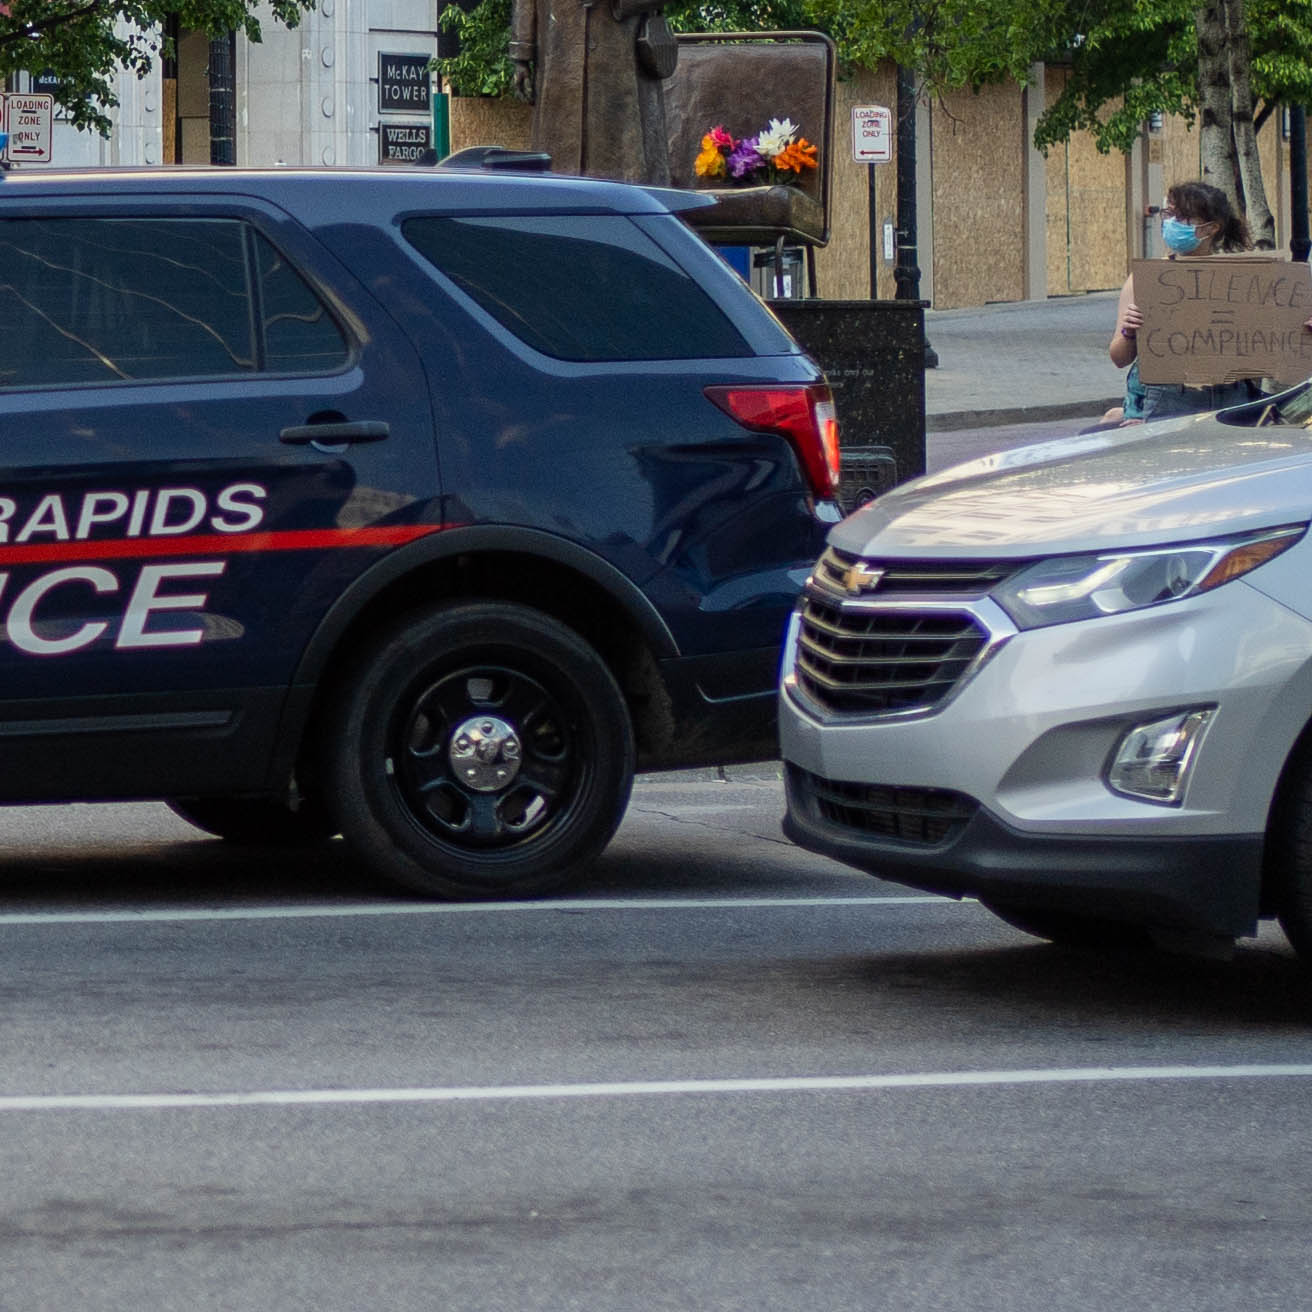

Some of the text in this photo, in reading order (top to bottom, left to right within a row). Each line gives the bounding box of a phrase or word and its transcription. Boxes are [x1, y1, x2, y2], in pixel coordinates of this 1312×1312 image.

[387, 65, 425, 80] McKAY
[384, 85, 427, 101] TOWER
[11, 100, 49, 110] LOADING
[18, 116, 41, 126] ZONE
[18, 131, 41, 141] ONLY
[386, 129, 426, 143] WELLS
[388, 146, 425, 160] FARGO
[1158, 269, 1307, 309] SILENCE
